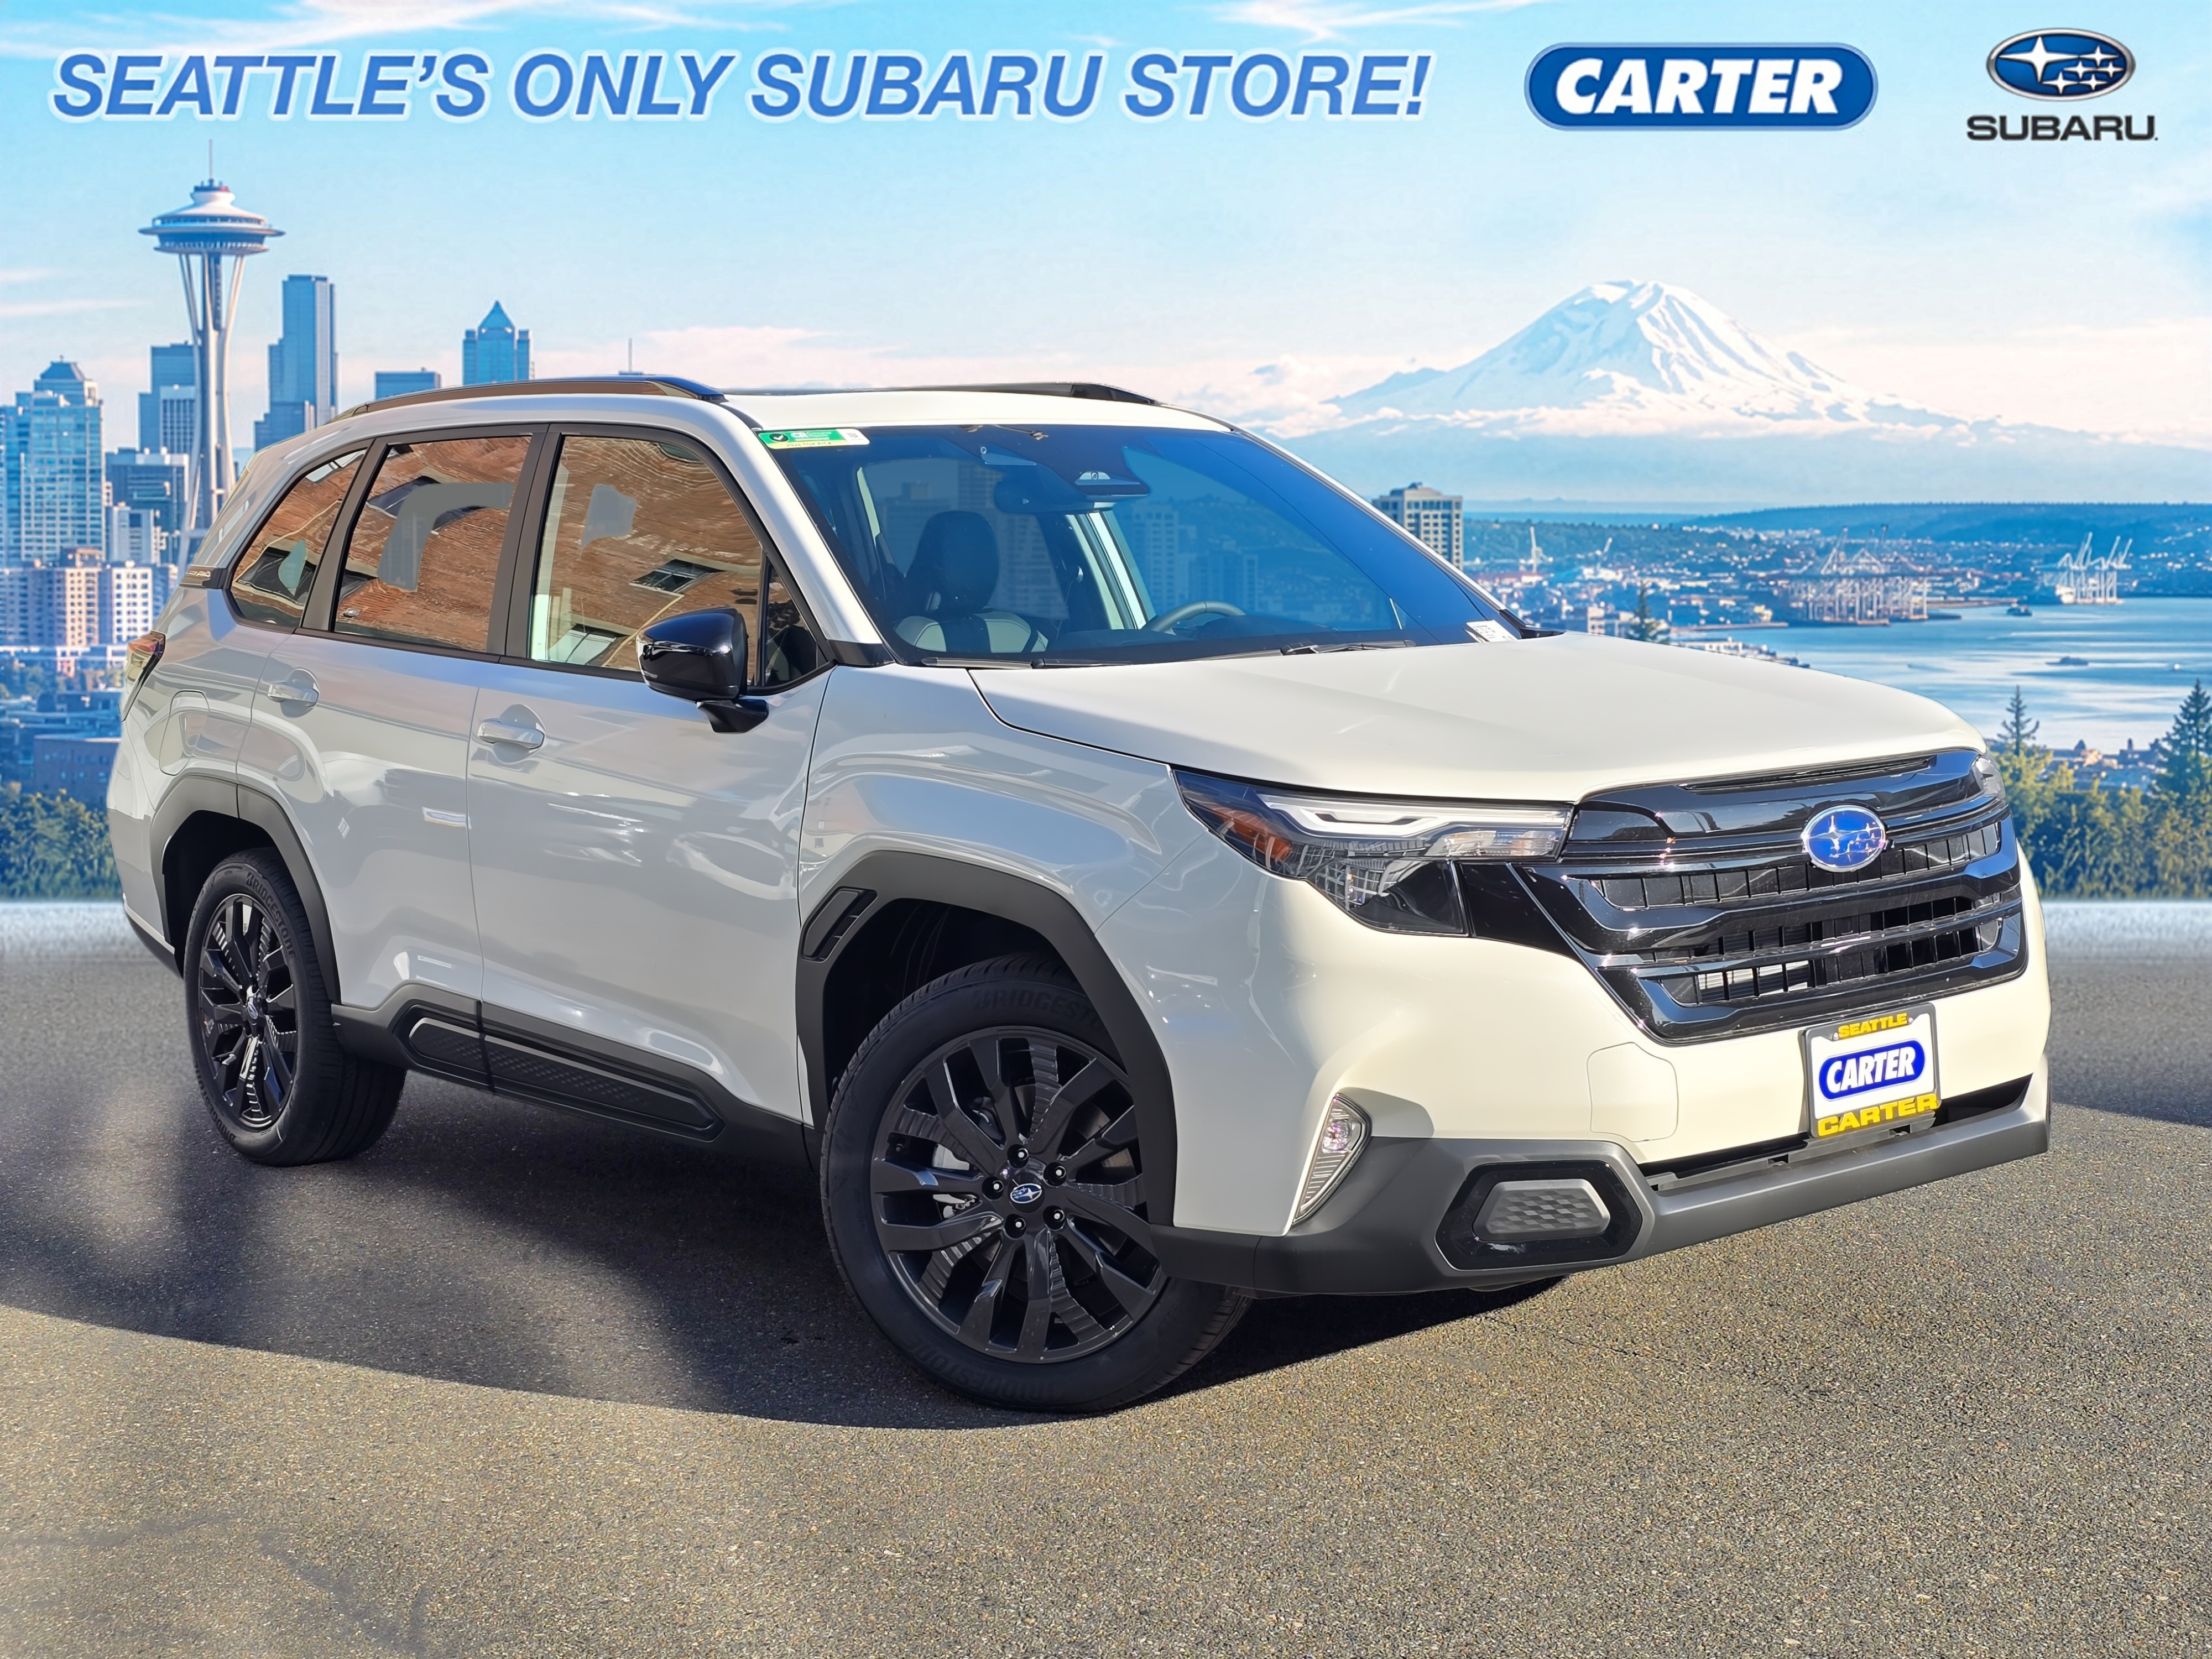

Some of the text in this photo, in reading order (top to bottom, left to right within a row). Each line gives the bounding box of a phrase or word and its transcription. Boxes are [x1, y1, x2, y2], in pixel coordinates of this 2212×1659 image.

[246, 871, 296, 959] BRIDGESTONE
[971, 988, 1105, 1032] BRIDGESTO
[1838, 1013, 1908, 1039] SEATTLE
[1826, 1046, 1916, 1093] CARTER
[1817, 1093, 1939, 1137] CARTER
